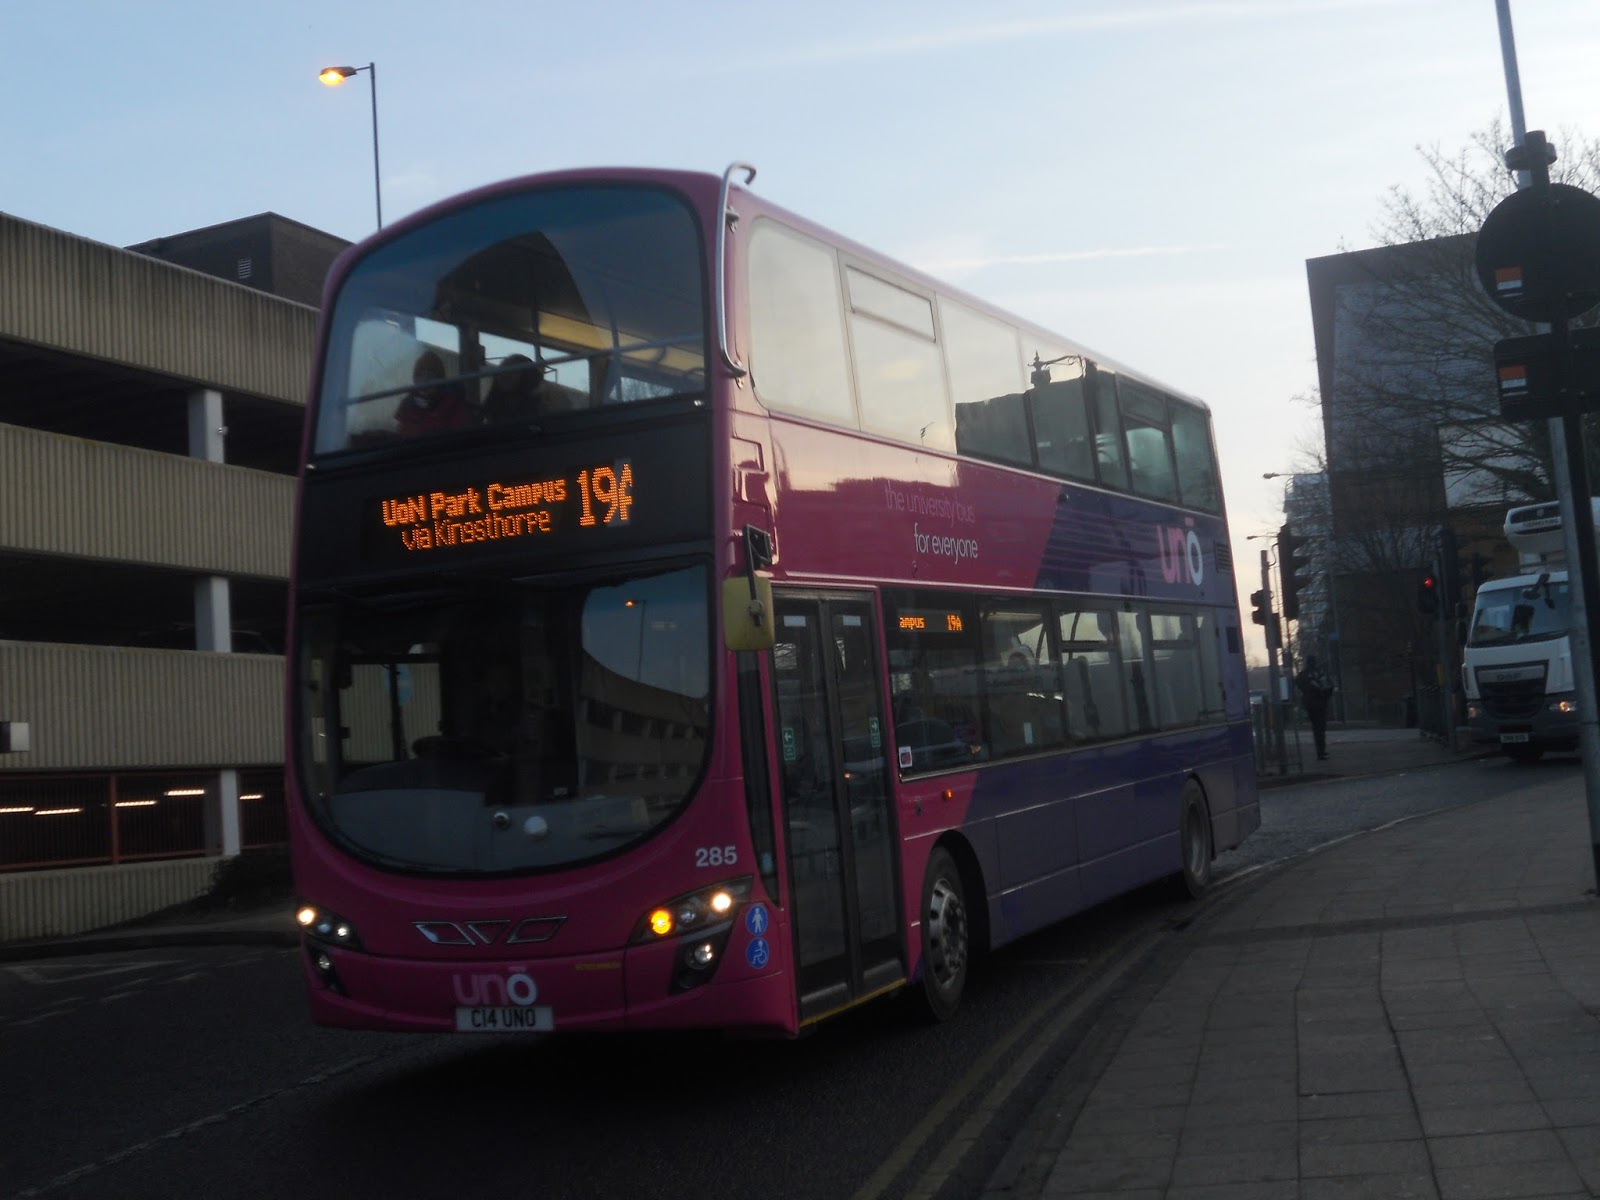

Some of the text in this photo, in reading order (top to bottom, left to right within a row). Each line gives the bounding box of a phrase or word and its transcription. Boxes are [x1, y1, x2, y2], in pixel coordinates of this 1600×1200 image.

[382, 479, 566, 526] UoN Park Campus
[884, 480, 976, 528] the university bus
[401, 511, 551, 550] via Kingsthorpe
[914, 523, 978, 564] for everyone
[947, 614, 963, 631] 19A
[695, 846, 738, 866] 285
[503, 1008, 535, 1028] UNO
